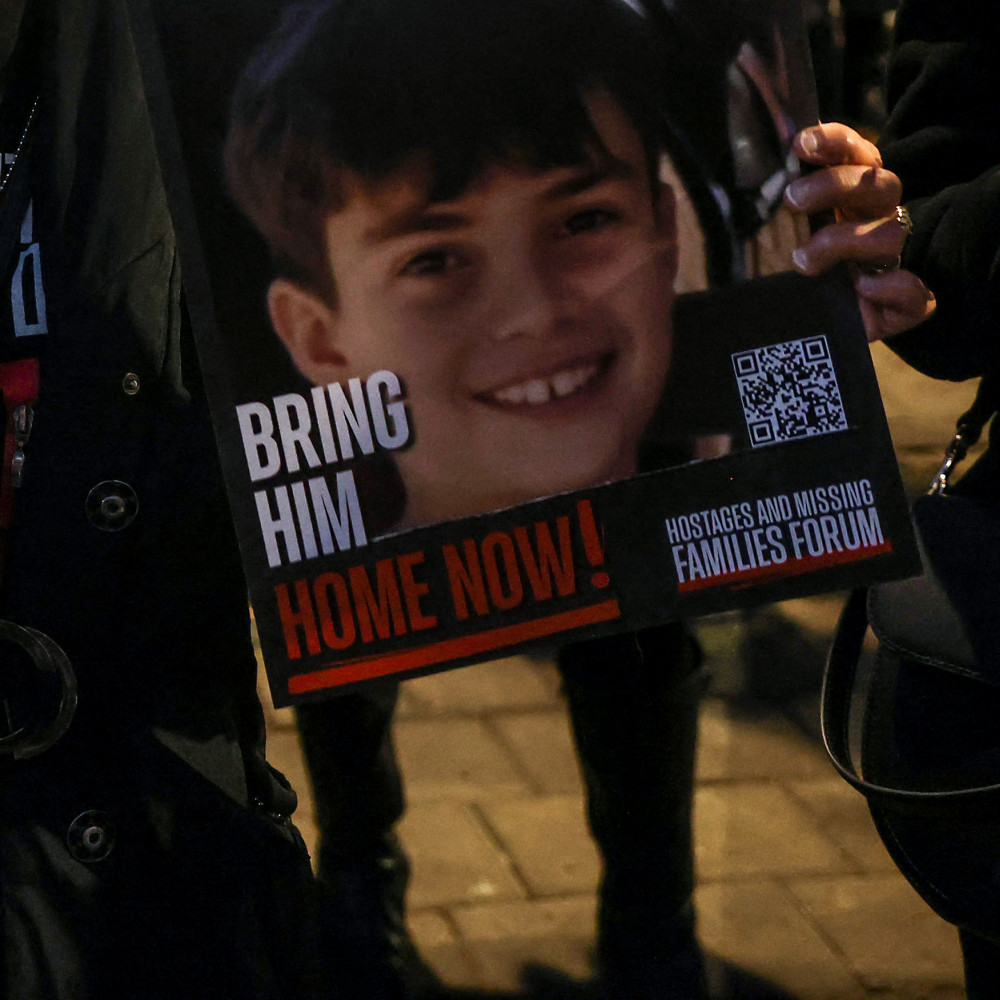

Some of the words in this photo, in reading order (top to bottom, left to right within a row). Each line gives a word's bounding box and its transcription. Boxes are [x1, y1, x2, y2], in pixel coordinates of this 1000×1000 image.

[235, 369, 410, 483] BRING
[253, 469, 368, 569] HIM
[665, 502, 755, 544] HOSTAGES
[756, 494, 793, 527] AND
[793, 478, 875, 518] MISSING
[671, 525, 788, 583] FAMILIES
[788, 506, 885, 561] FORUM
[274, 551, 438, 660] HOME
[442, 499, 611, 621] NOW!
